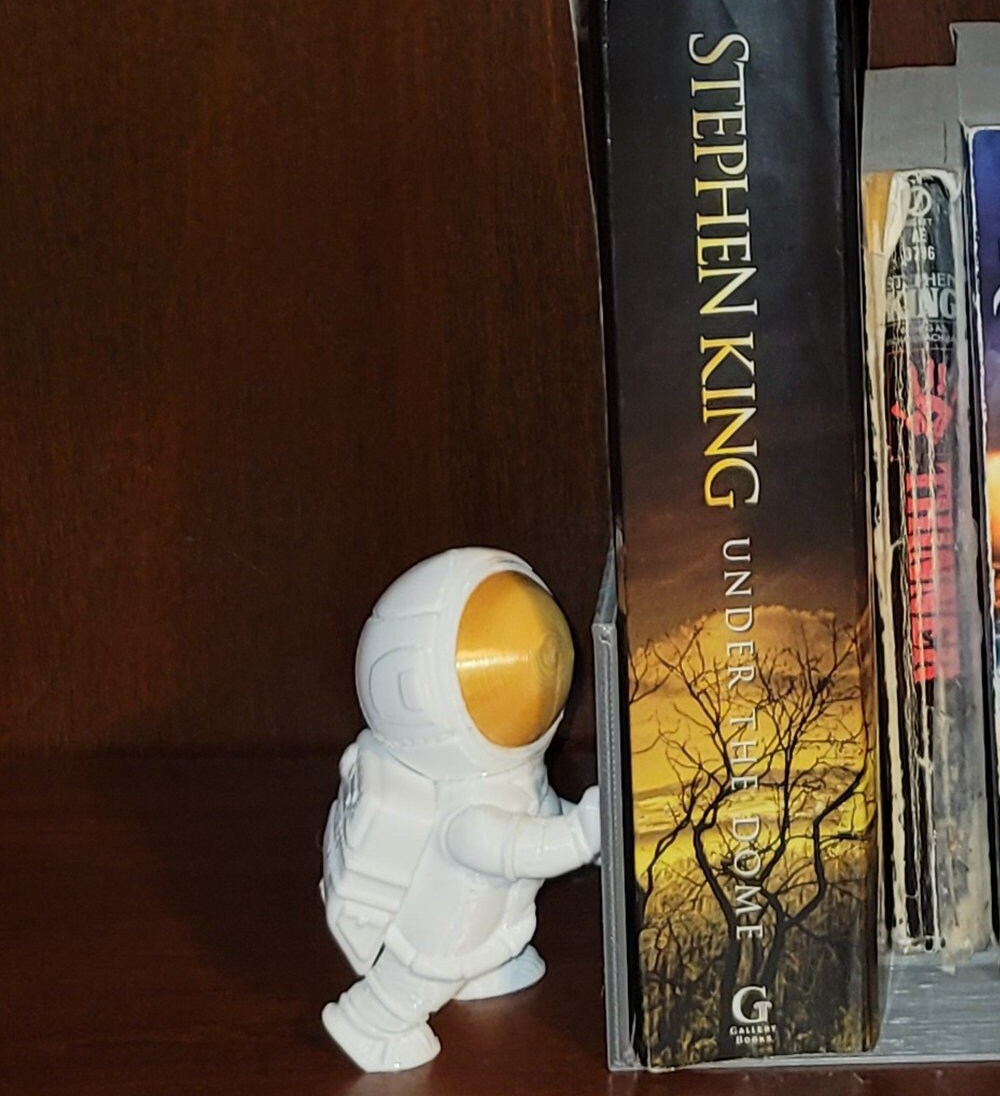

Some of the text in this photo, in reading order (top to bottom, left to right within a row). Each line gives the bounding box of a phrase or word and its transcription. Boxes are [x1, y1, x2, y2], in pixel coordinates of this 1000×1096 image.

[688, 32, 760, 509] STEPHEN KING
[722, 537, 764, 941] UNDER THE DOME
